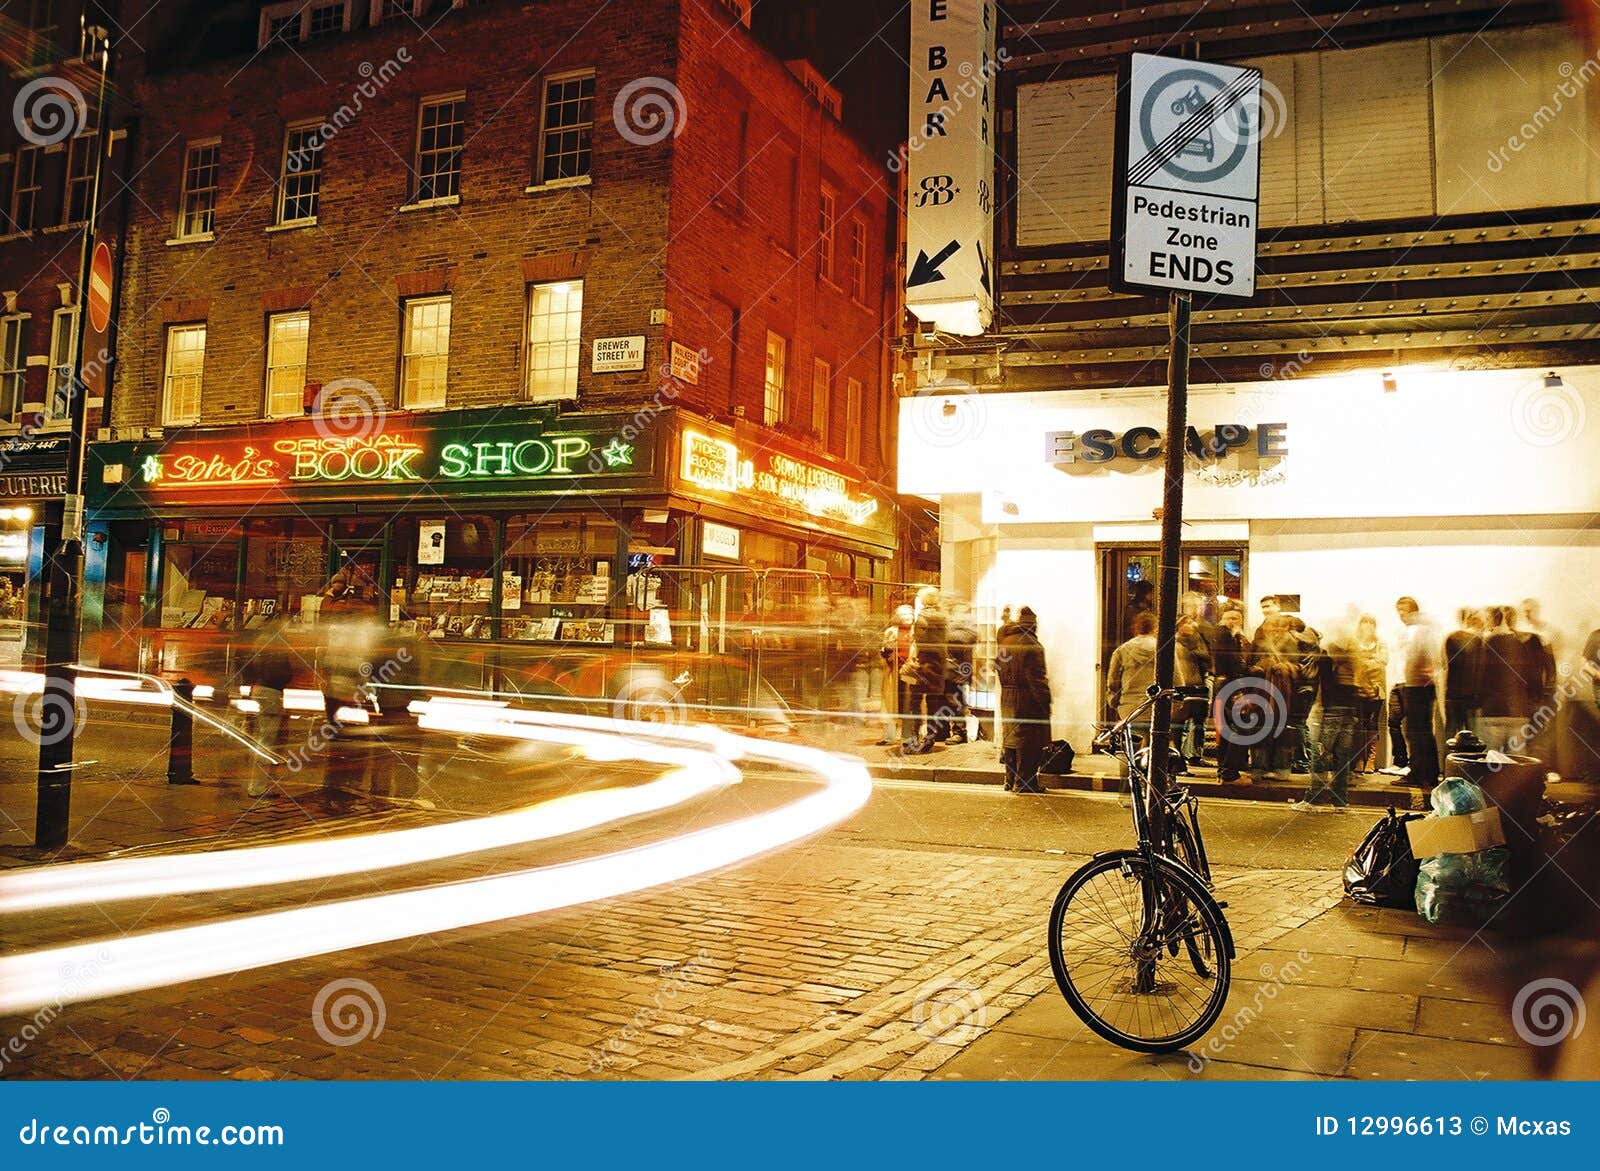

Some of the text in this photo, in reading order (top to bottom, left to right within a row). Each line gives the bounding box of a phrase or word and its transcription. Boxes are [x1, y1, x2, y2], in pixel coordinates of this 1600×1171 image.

[925, 45, 950, 137] BAR
[1134, 196, 1250, 228] Pedestrian
[1166, 227, 1218, 251] Zone
[1149, 251, 1234, 286] ENDS
[597, 341, 630, 351] BREWER
[597, 350, 639, 361] STREET W1
[274, 434, 418, 453] ORIGINAL
[289, 448, 425, 481] BOOK
[439, 437, 591, 478] SHOP
[1045, 423, 1288, 463] ESCAPE
